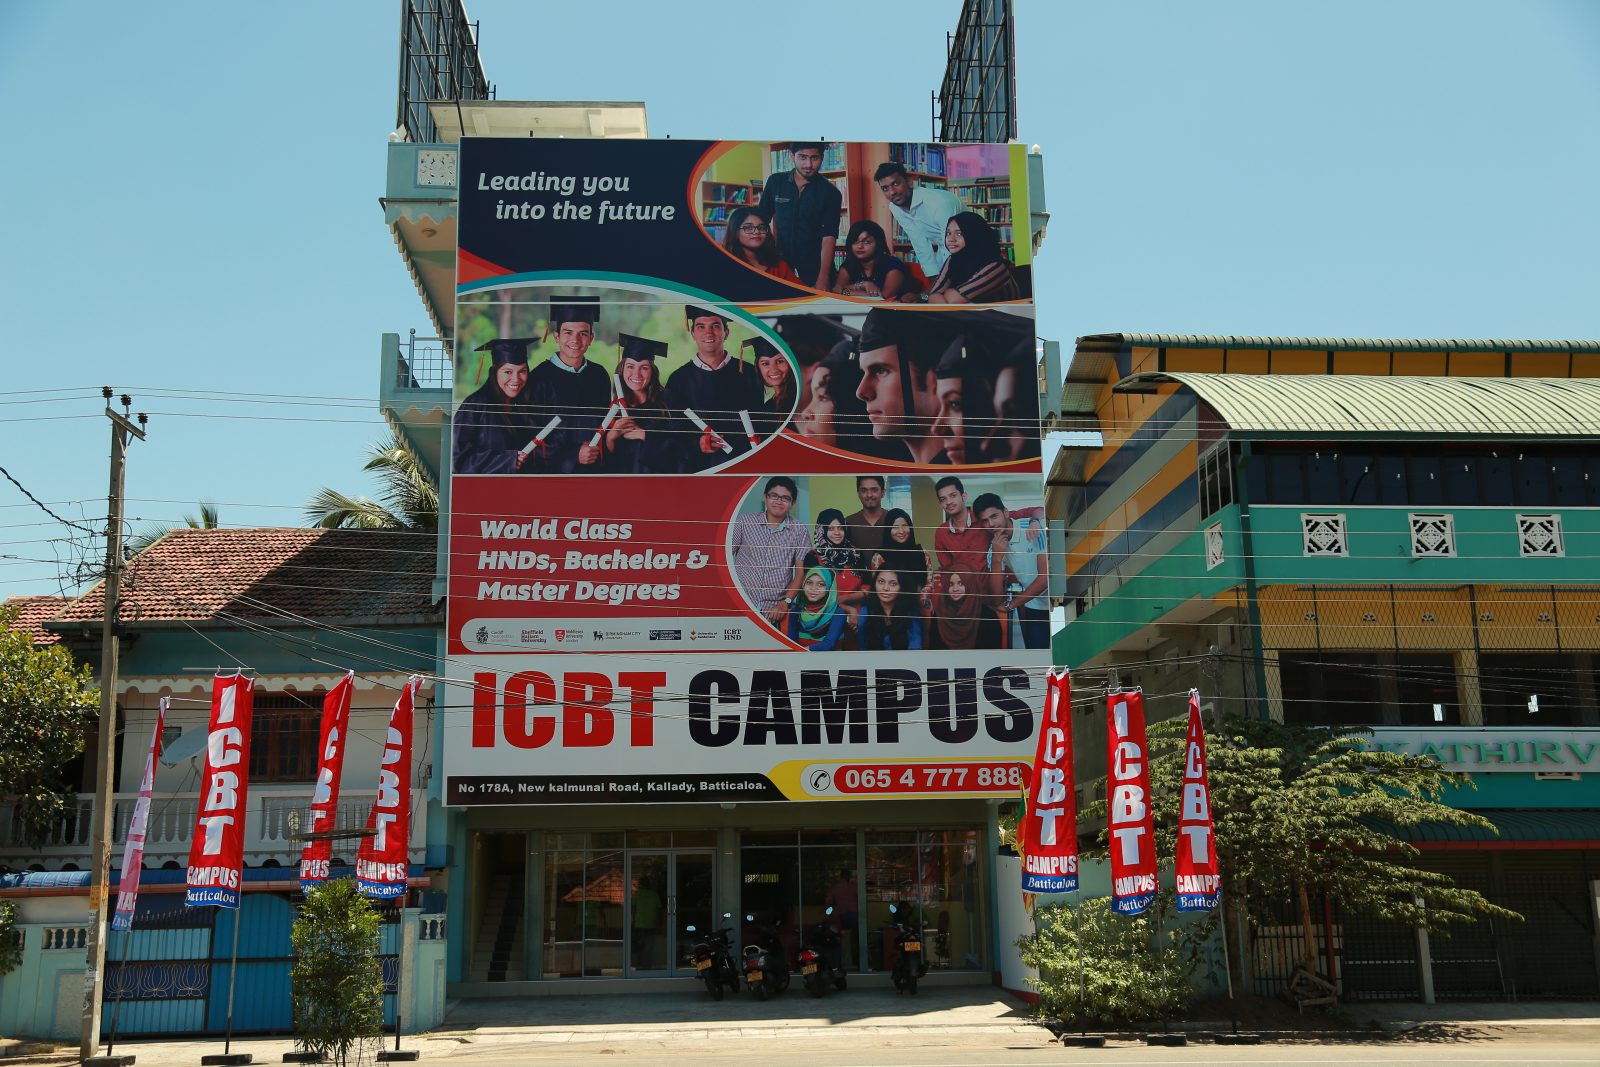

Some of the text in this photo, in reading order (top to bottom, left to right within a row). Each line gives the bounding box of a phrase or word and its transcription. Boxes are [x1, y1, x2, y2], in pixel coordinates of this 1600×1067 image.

[478, 171, 630, 196] Leading you
[495, 199, 676, 225] into the future
[479, 519, 632, 540] World Class
[477, 549, 709, 573] HNDs, Bachelor &
[477, 581, 681, 606] Master Degrees
[472, 665, 1034, 749] ICBT CAMPUS
[458, 780, 766, 795] No 178A, New kalmunai Road, Kallady, Batticaloa.
[845, 766, 1022, 788] 065 4 777 888
[356, 862, 406, 881] CAMPUS
[1026, 855, 1077, 875] CAMPUS
[186, 865, 239, 889] CAMPUS
[1028, 876, 1076, 890] Batticaloa
[1115, 872, 1156, 896] CAMPUS
[186, 888, 236, 904] Batticaloa
